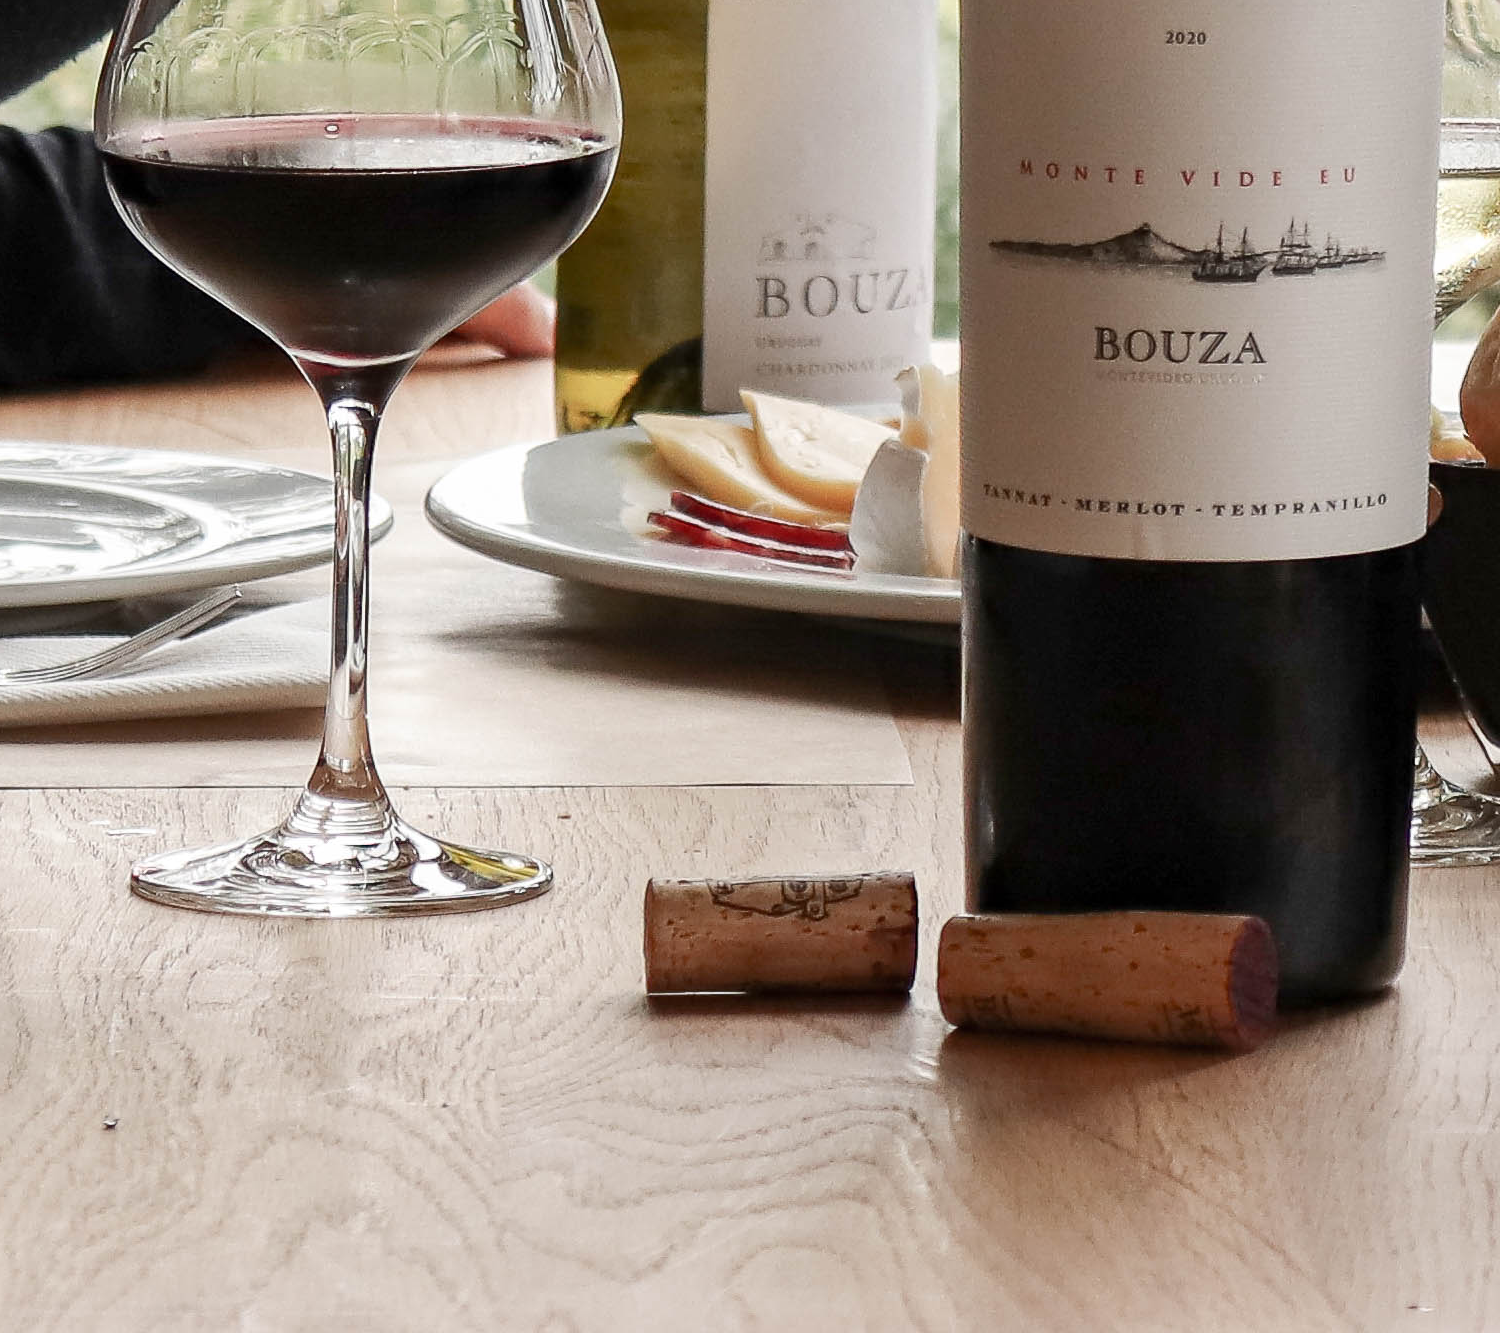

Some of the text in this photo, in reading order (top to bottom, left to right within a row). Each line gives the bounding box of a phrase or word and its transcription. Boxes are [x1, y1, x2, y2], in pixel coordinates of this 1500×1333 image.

[1165, 30, 1206, 45] 2020
[1019, 159, 1356, 187] MONTE VIDE EU
[1093, 326, 1267, 364] BOUZA
[982, 483, 1052, 507] TANNAT
[1075, 498, 1185, 516] MERLOT
[1212, 493, 1388, 517] TEMPRANILLO
